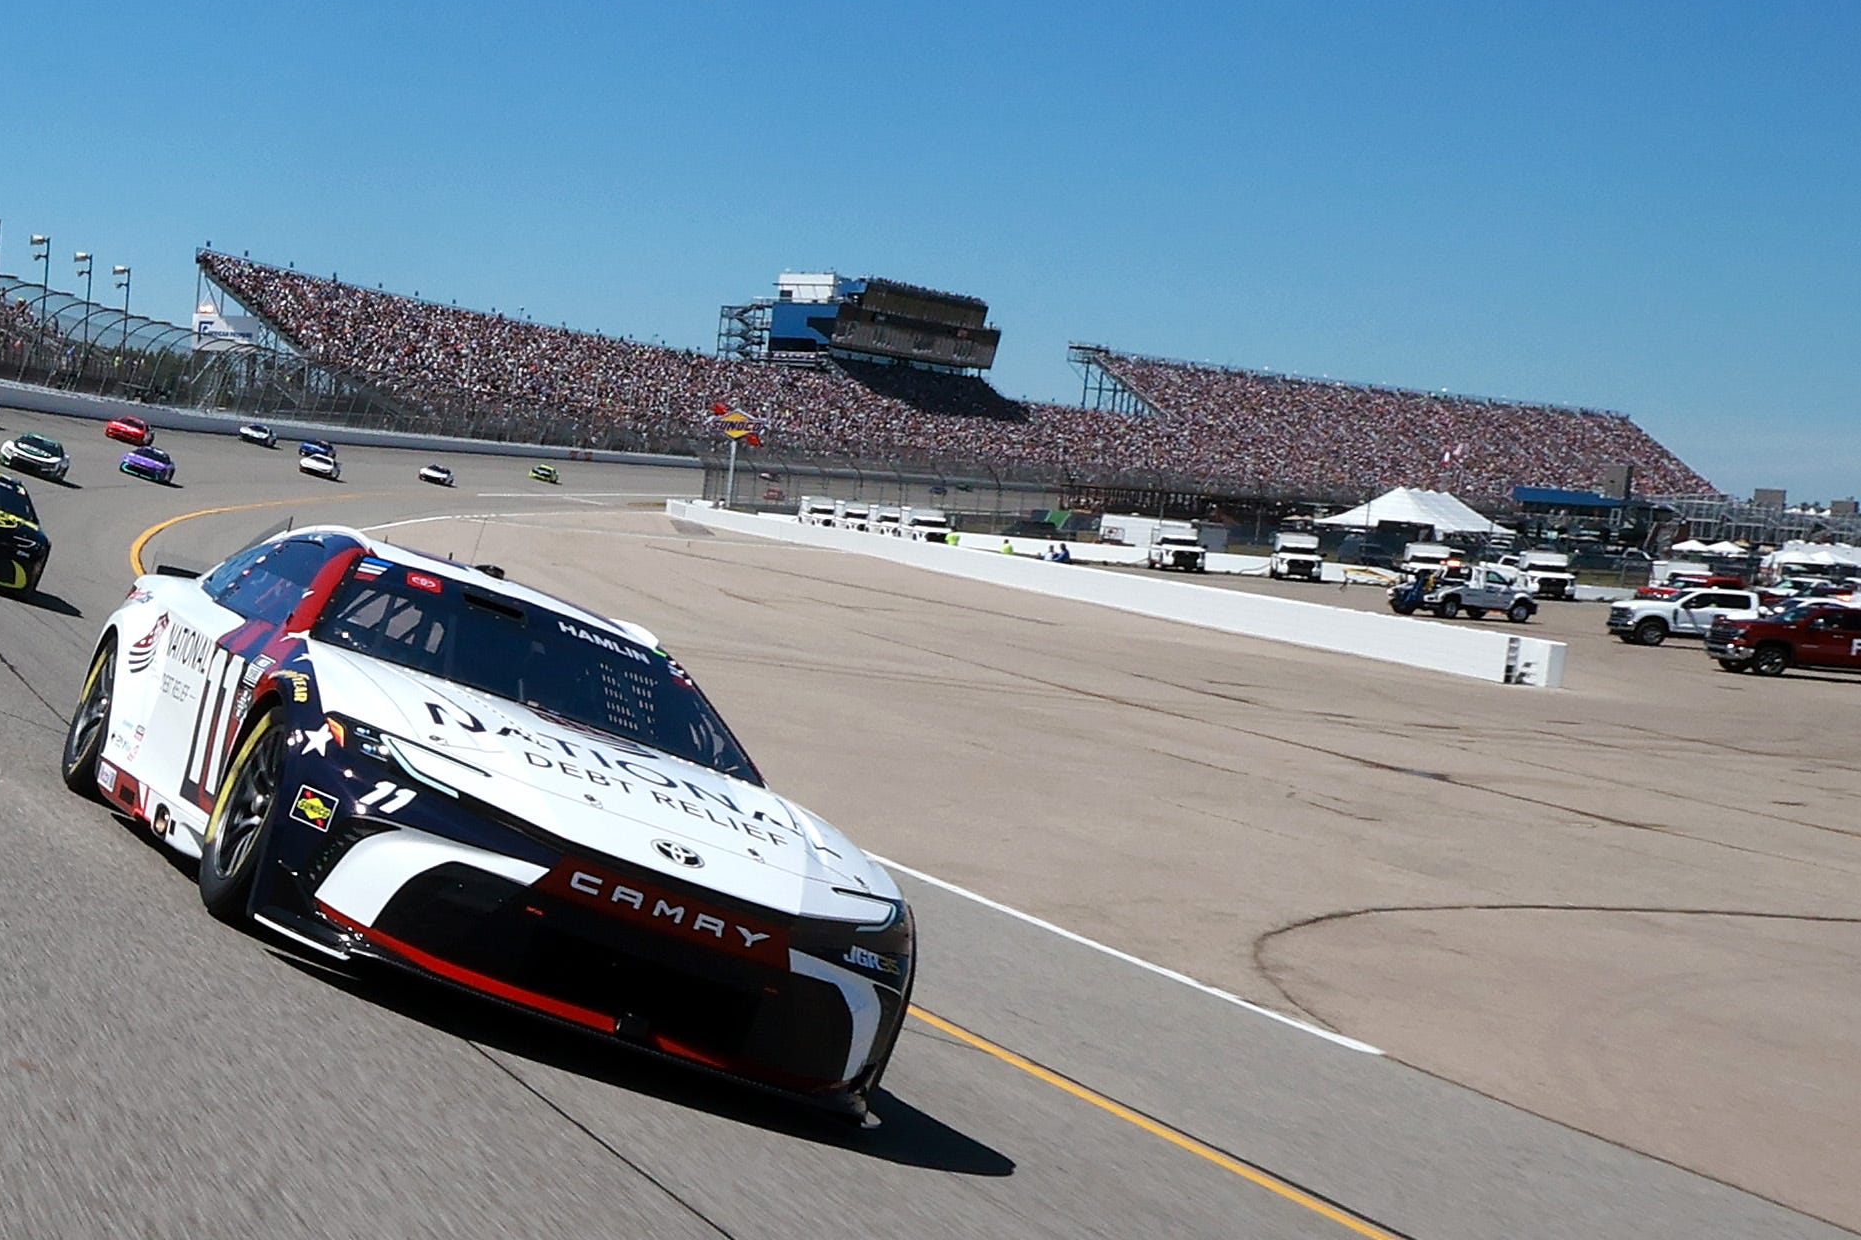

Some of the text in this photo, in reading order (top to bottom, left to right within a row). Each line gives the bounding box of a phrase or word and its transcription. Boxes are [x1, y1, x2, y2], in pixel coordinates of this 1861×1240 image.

[708, 419, 765, 432] SUNOCO
[166, 623, 213, 674] NATIONAL
[558, 620, 651, 665] HAMLIN
[189, 646, 246, 797] 11
[359, 781, 418, 814] 11
[424, 702, 842, 860] NATIONAL
[524, 751, 788, 847] DEBT RELIEF
[297, 798, 332, 819] SUNOCO
[570, 871, 771, 948] CAMRY
